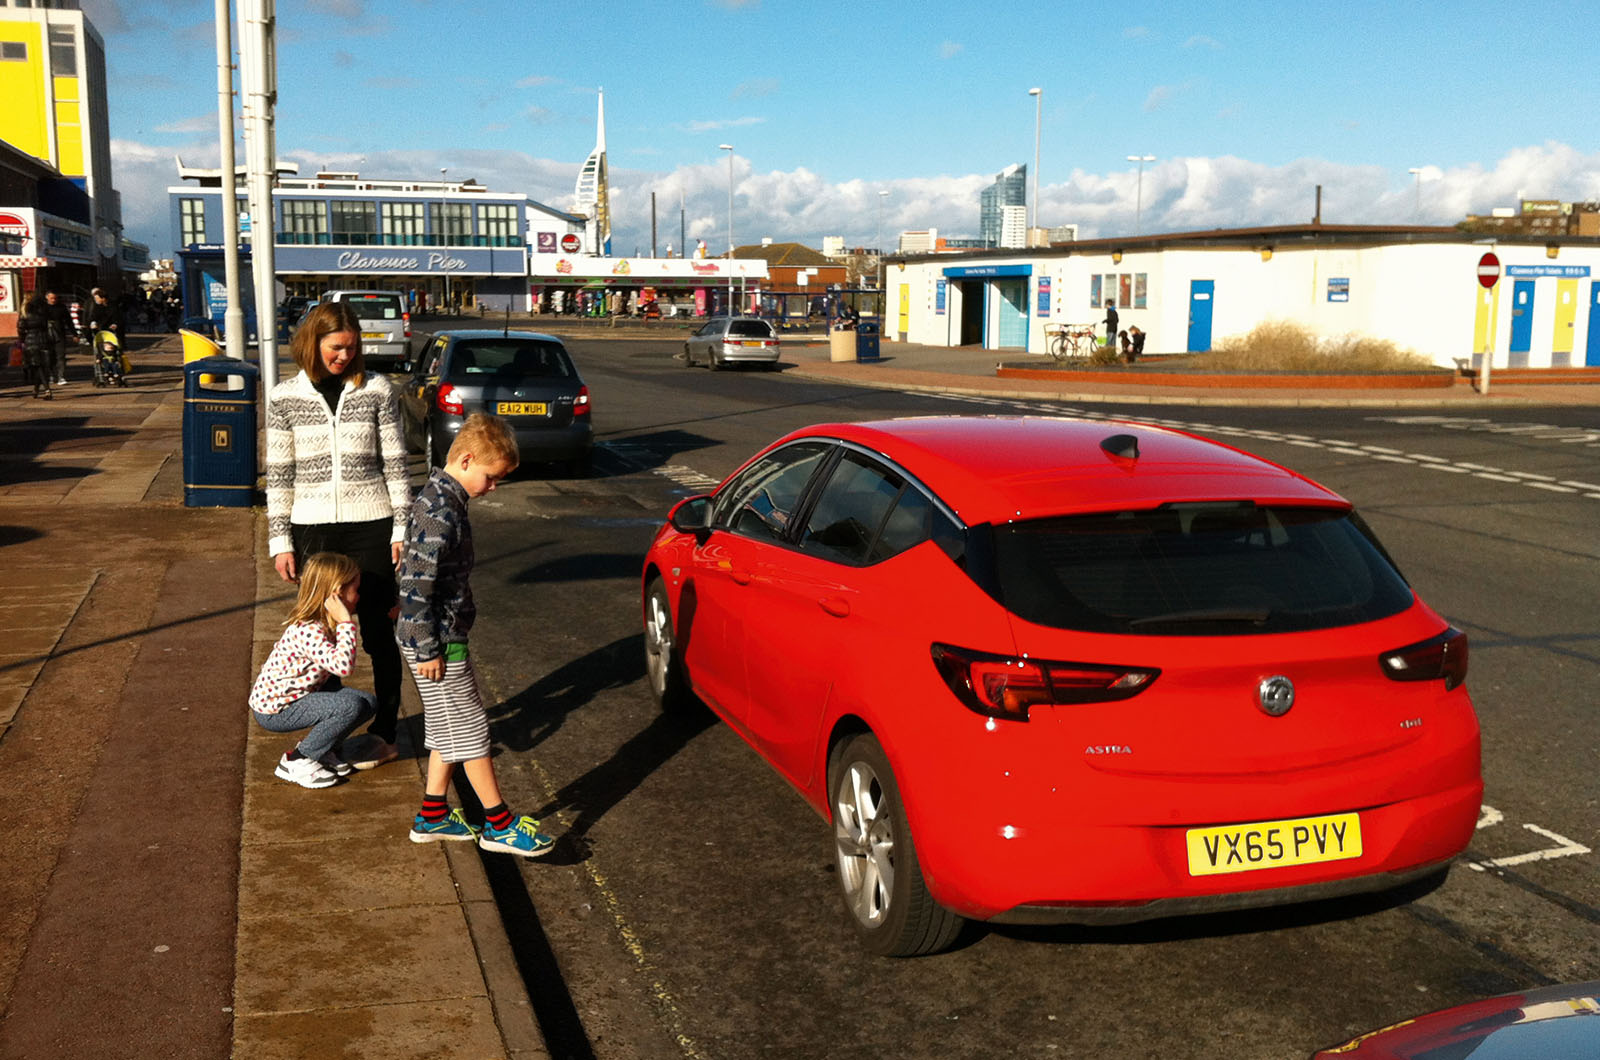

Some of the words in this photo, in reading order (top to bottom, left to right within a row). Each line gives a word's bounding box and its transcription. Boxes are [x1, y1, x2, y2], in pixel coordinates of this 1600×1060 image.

[337, 251, 418, 270] Clarence
[427, 252, 467, 270] Pier
[500, 403, 521, 414] EA12
[1085, 745, 1132, 754] ASTRA
[1203, 828, 1284, 867] VX65
[1293, 821, 1347, 858] PVY
